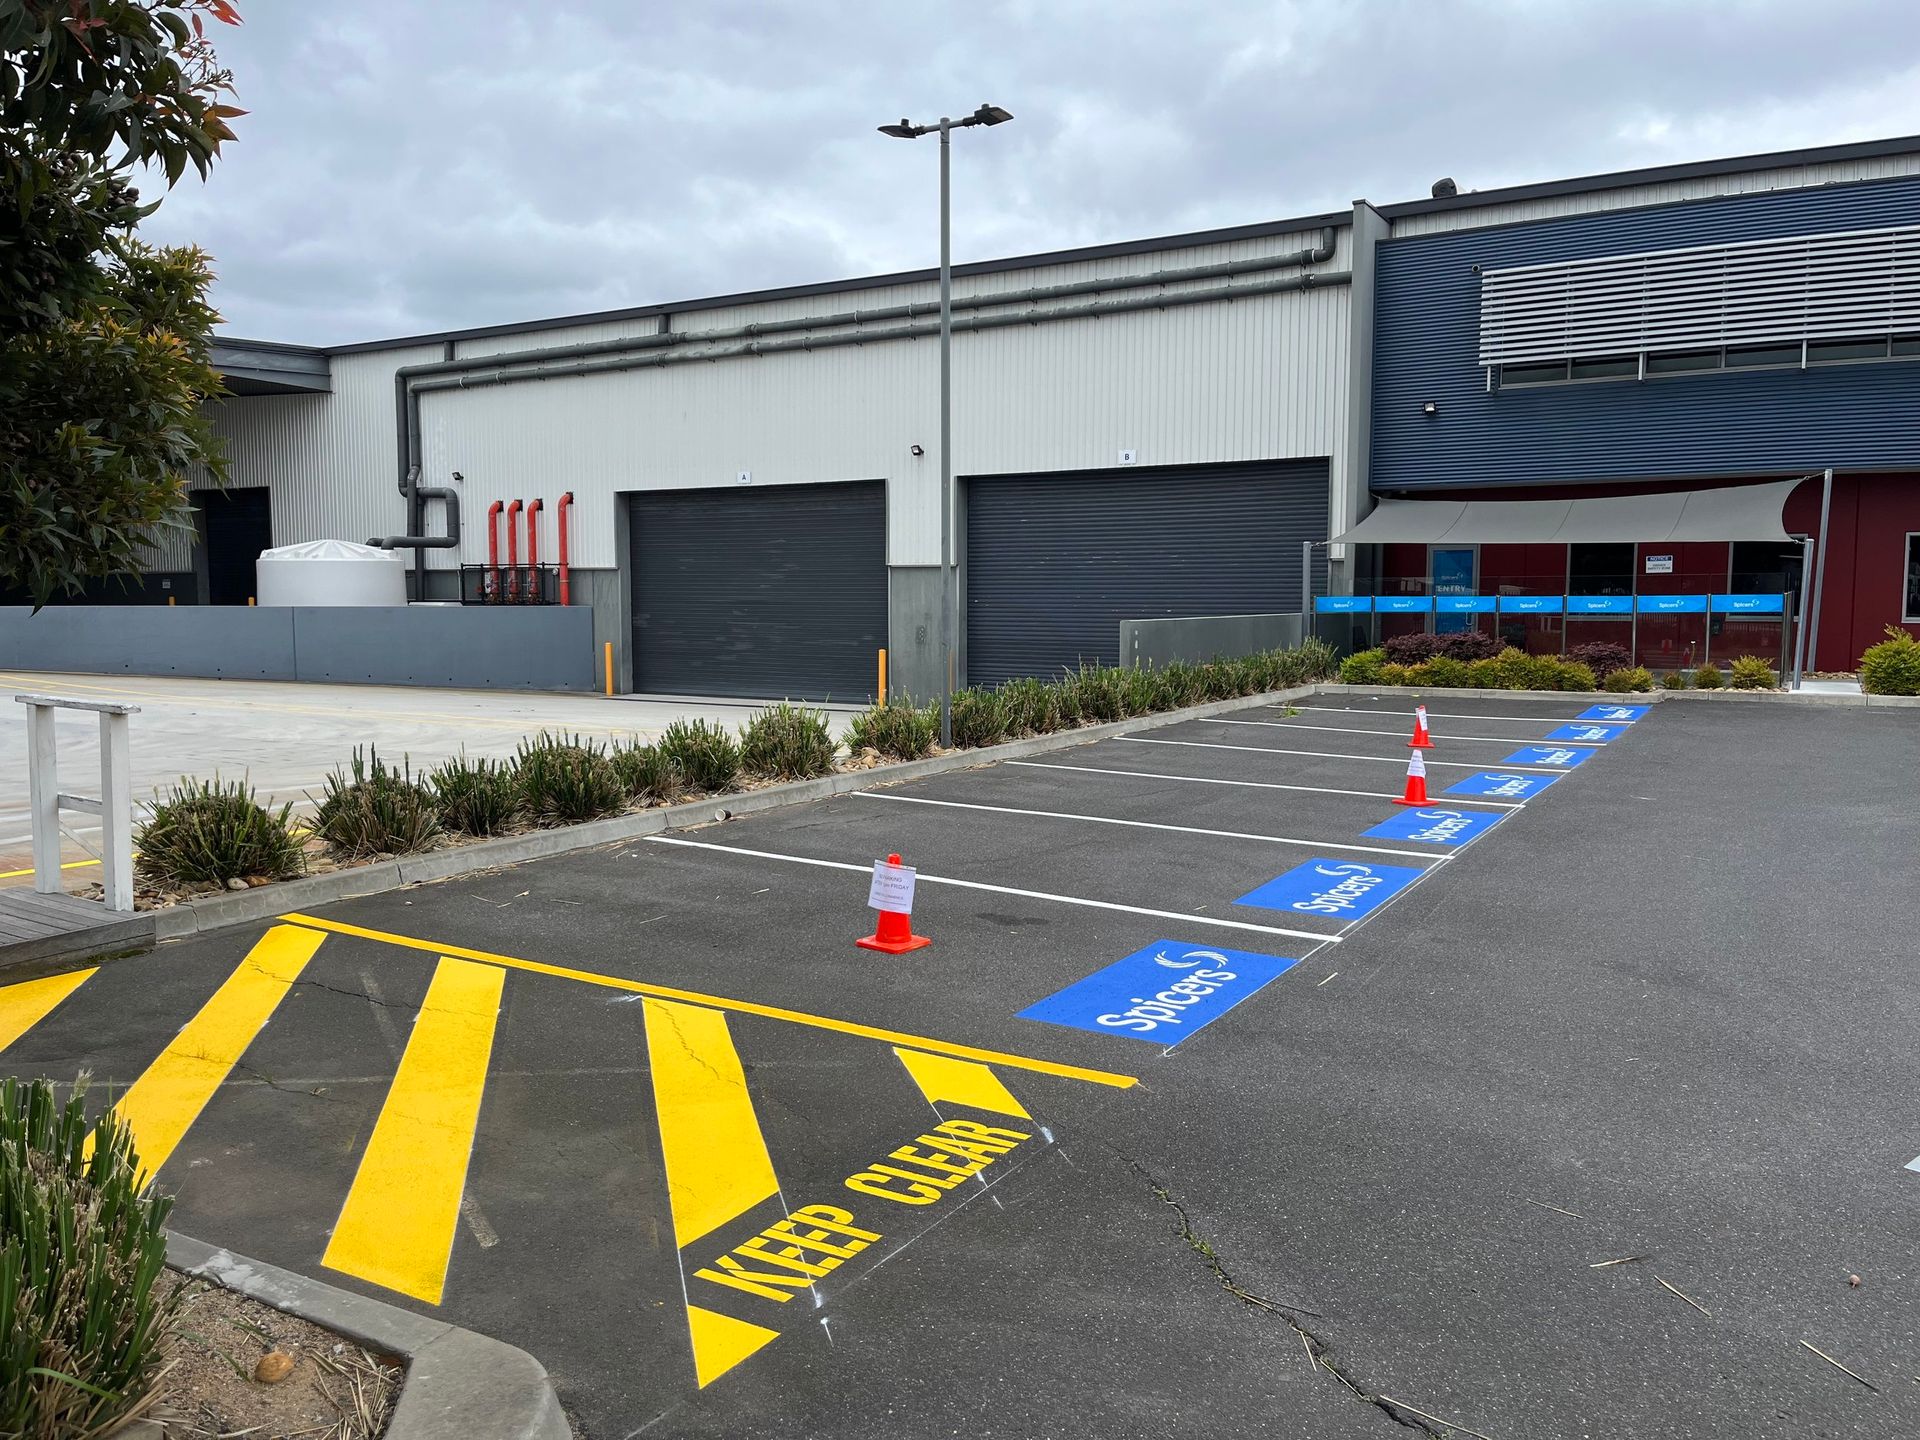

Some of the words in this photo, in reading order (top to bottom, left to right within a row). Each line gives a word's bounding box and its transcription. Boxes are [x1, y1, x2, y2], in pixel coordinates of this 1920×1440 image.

[1125, 453, 1130, 461] B
[1437, 585, 1466, 593] ENTRY
[1483, 779, 1535, 796] Spicers
[1408, 817, 1473, 842] Spicers
[1292, 873, 1383, 913] Spicers
[1096, 967, 1238, 1032] Spicers
[692, 1204, 884, 1303] KEEP
[844, 1119, 1033, 1206] CLEAR
